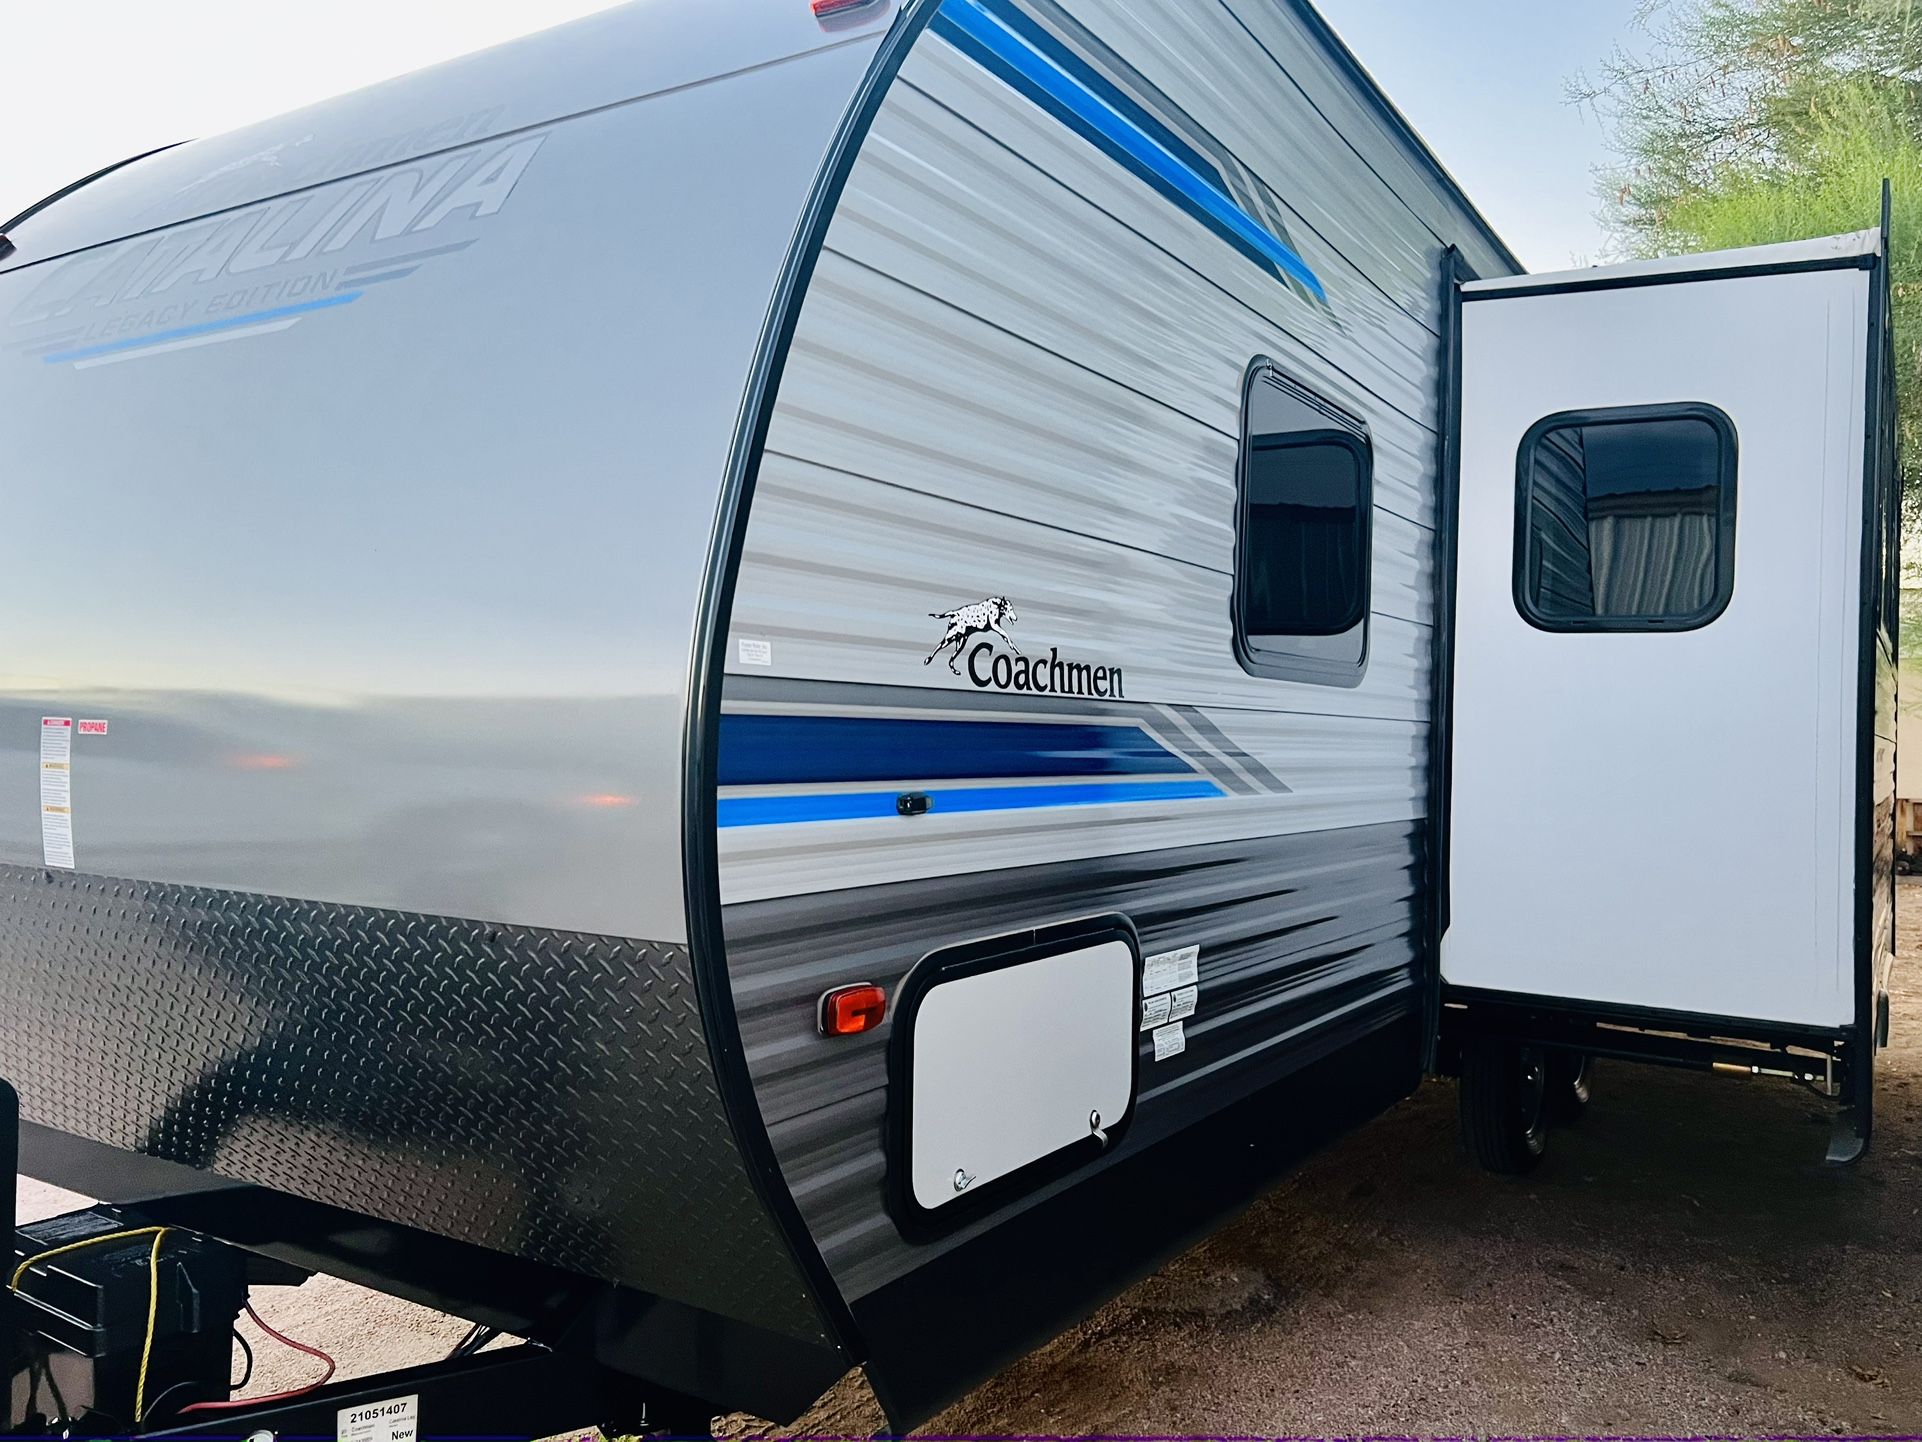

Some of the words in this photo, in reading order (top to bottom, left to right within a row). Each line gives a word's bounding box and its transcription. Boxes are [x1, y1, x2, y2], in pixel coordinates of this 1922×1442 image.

[7, 129, 554, 328] CATALINA
[83, 301, 196, 342] LEGACY
[204, 267, 338, 315] EDITION
[967, 641, 1125, 699] Coachmen
[80, 721, 106, 733] PROPANE
[350, 1402, 408, 1424] 21051407
[391, 1429, 414, 1441] New
